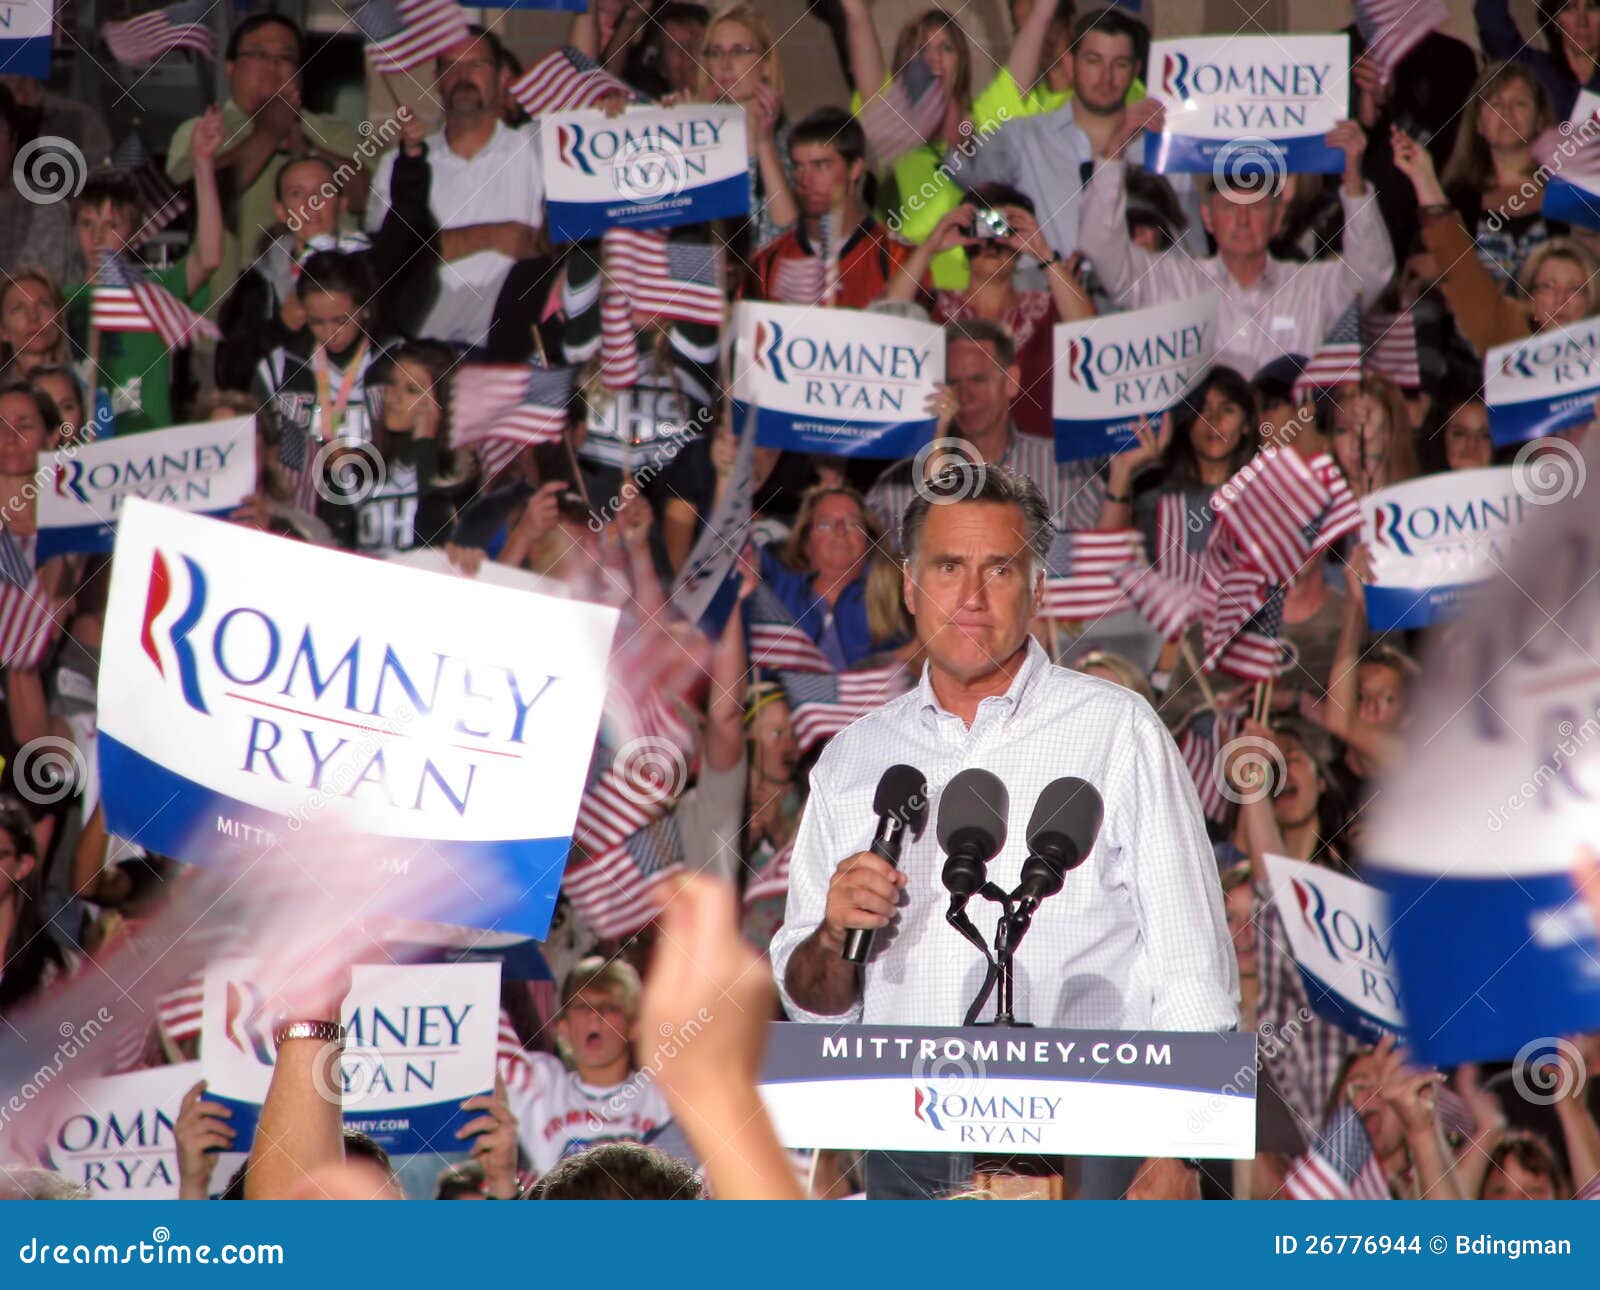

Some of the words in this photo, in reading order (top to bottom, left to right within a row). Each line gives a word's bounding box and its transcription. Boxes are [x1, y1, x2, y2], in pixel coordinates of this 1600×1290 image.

[1162, 52, 1331, 101] ROMNEY
[1213, 104, 1306, 128] RYAN
[557, 118, 727, 176] ROMNEY
[615, 154, 706, 188] RYAN
[754, 320, 930, 384] ROMNEY
[1069, 321, 1208, 392] ROMNEY
[1502, 332, 1600, 378] ROM
[805, 381, 904, 412] RYAN
[1115, 367, 1192, 406] RYAN
[55, 441, 236, 504] ROMNEY
[1375, 495, 1524, 556] ROMN
[240, 715, 478, 818] RYAN
[1290, 876, 1393, 965] ROM
[1361, 968, 1401, 1009] RY
[821, 1036, 1172, 1065] MITTROMNEY.COM
[340, 1060, 436, 1093] YAN
[914, 1086, 1062, 1131] ROMNEY
[960, 1125, 1042, 1144] RYAN
[84, 1157, 174, 1191] RYA
